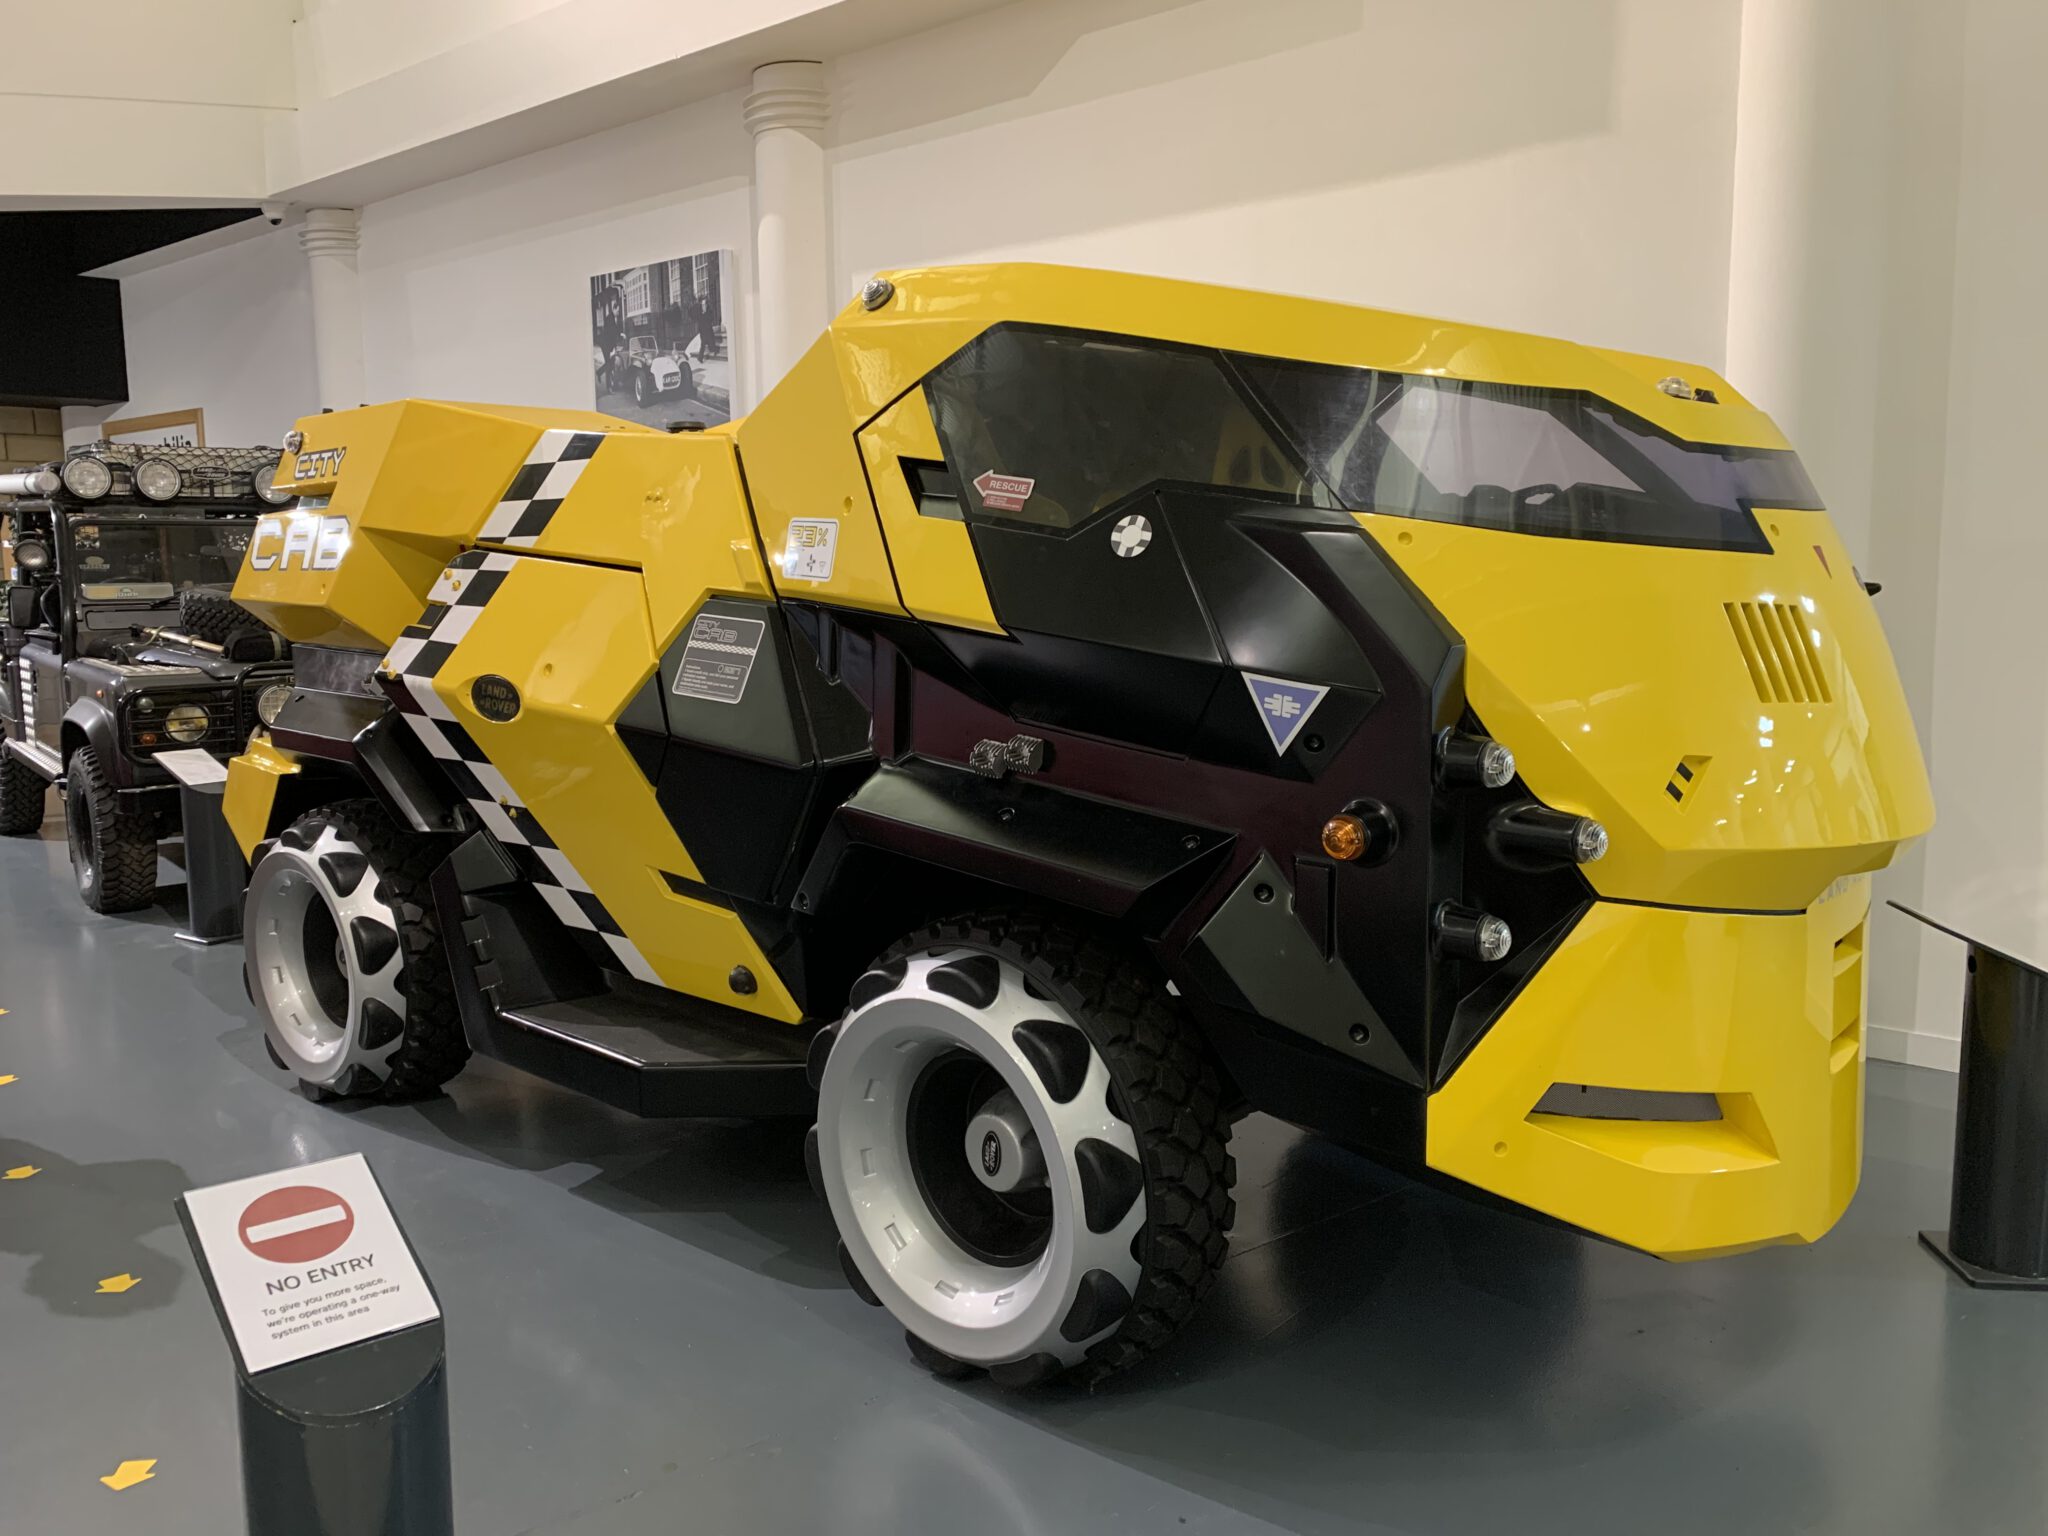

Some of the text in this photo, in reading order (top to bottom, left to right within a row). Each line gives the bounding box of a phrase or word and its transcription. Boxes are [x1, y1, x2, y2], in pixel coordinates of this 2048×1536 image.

[294, 446, 347, 480] CITY
[989, 480, 1028, 493] RESCUE
[250, 515, 350, 571] CAB
[694, 626, 738, 643] CAB
[265, 1253, 375, 1295] NO ENTRY
[261, 1276, 388, 1317] To give you more space,
[266, 1315, 296, 1328] we're
[298, 1300, 349, 1322] operating
[359, 1284, 401, 1302] one-way
[270, 1306, 370, 1340] system in this area
